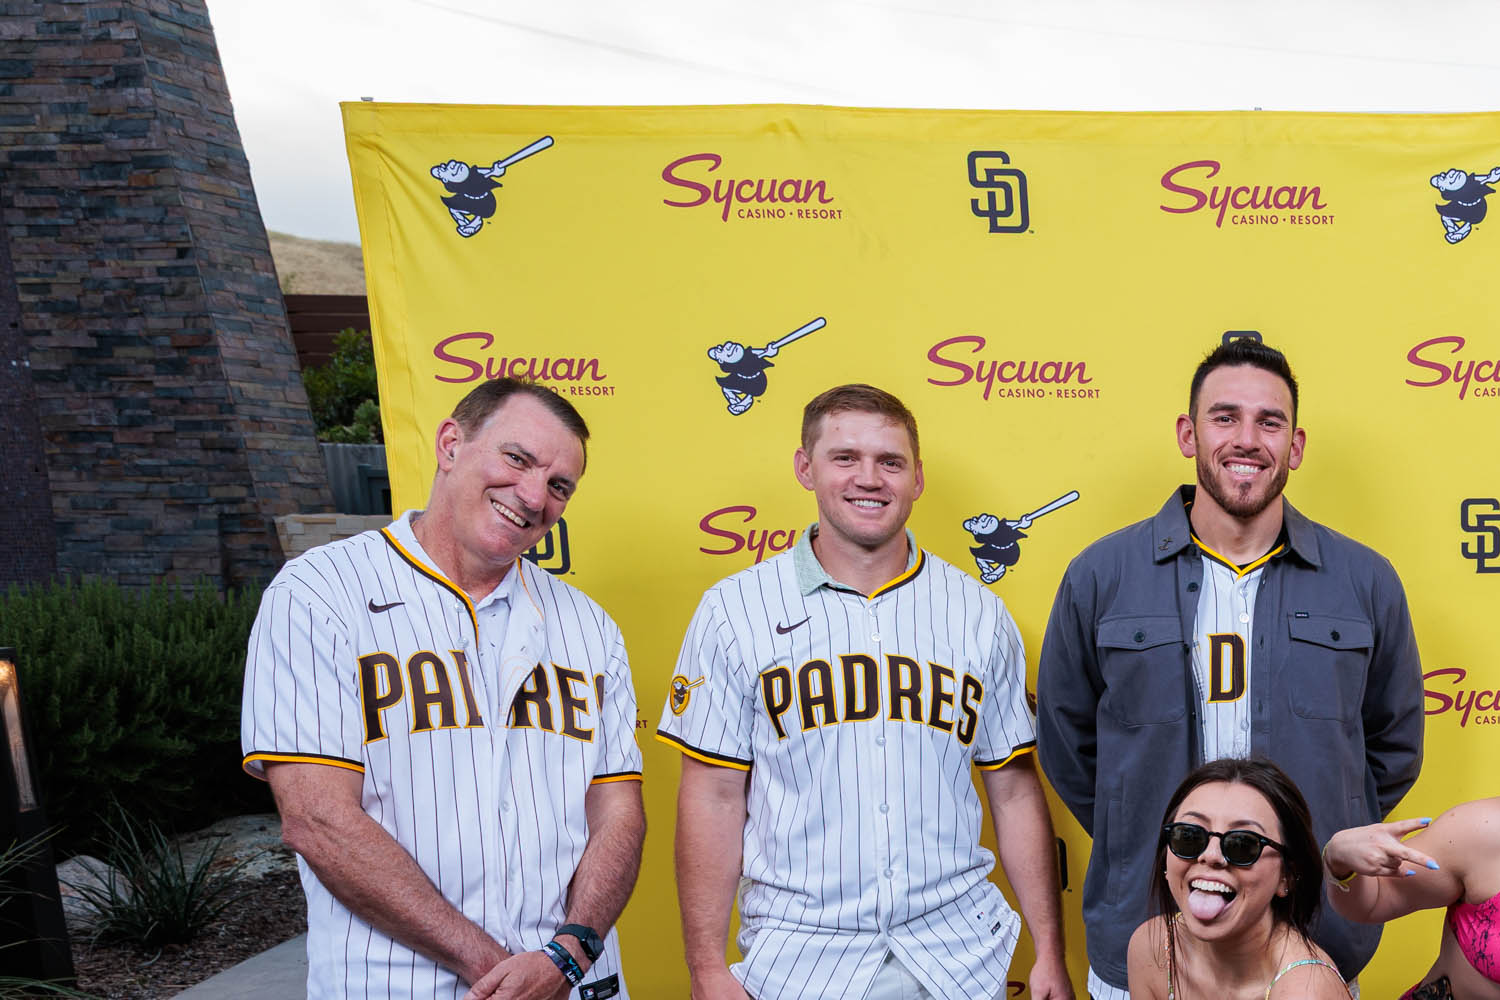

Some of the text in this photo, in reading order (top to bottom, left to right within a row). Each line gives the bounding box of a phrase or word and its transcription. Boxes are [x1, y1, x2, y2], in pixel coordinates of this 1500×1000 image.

[661, 153, 834, 222] Sycuan
[738, 208, 842, 220] CASINO RESORT
[967, 151, 1029, 233] SD
[1160, 160, 1327, 228] Sycuan
[1232, 215, 1335, 225] CASINO RESORT
[570, 386, 615, 396] RESORT
[928, 335, 1093, 401] Sycuan
[998, 388, 1100, 398] CASINO RESORT
[699, 505, 796, 565] Syc
[356, 650, 605, 745] PARE
[759, 653, 984, 747] PADRES
